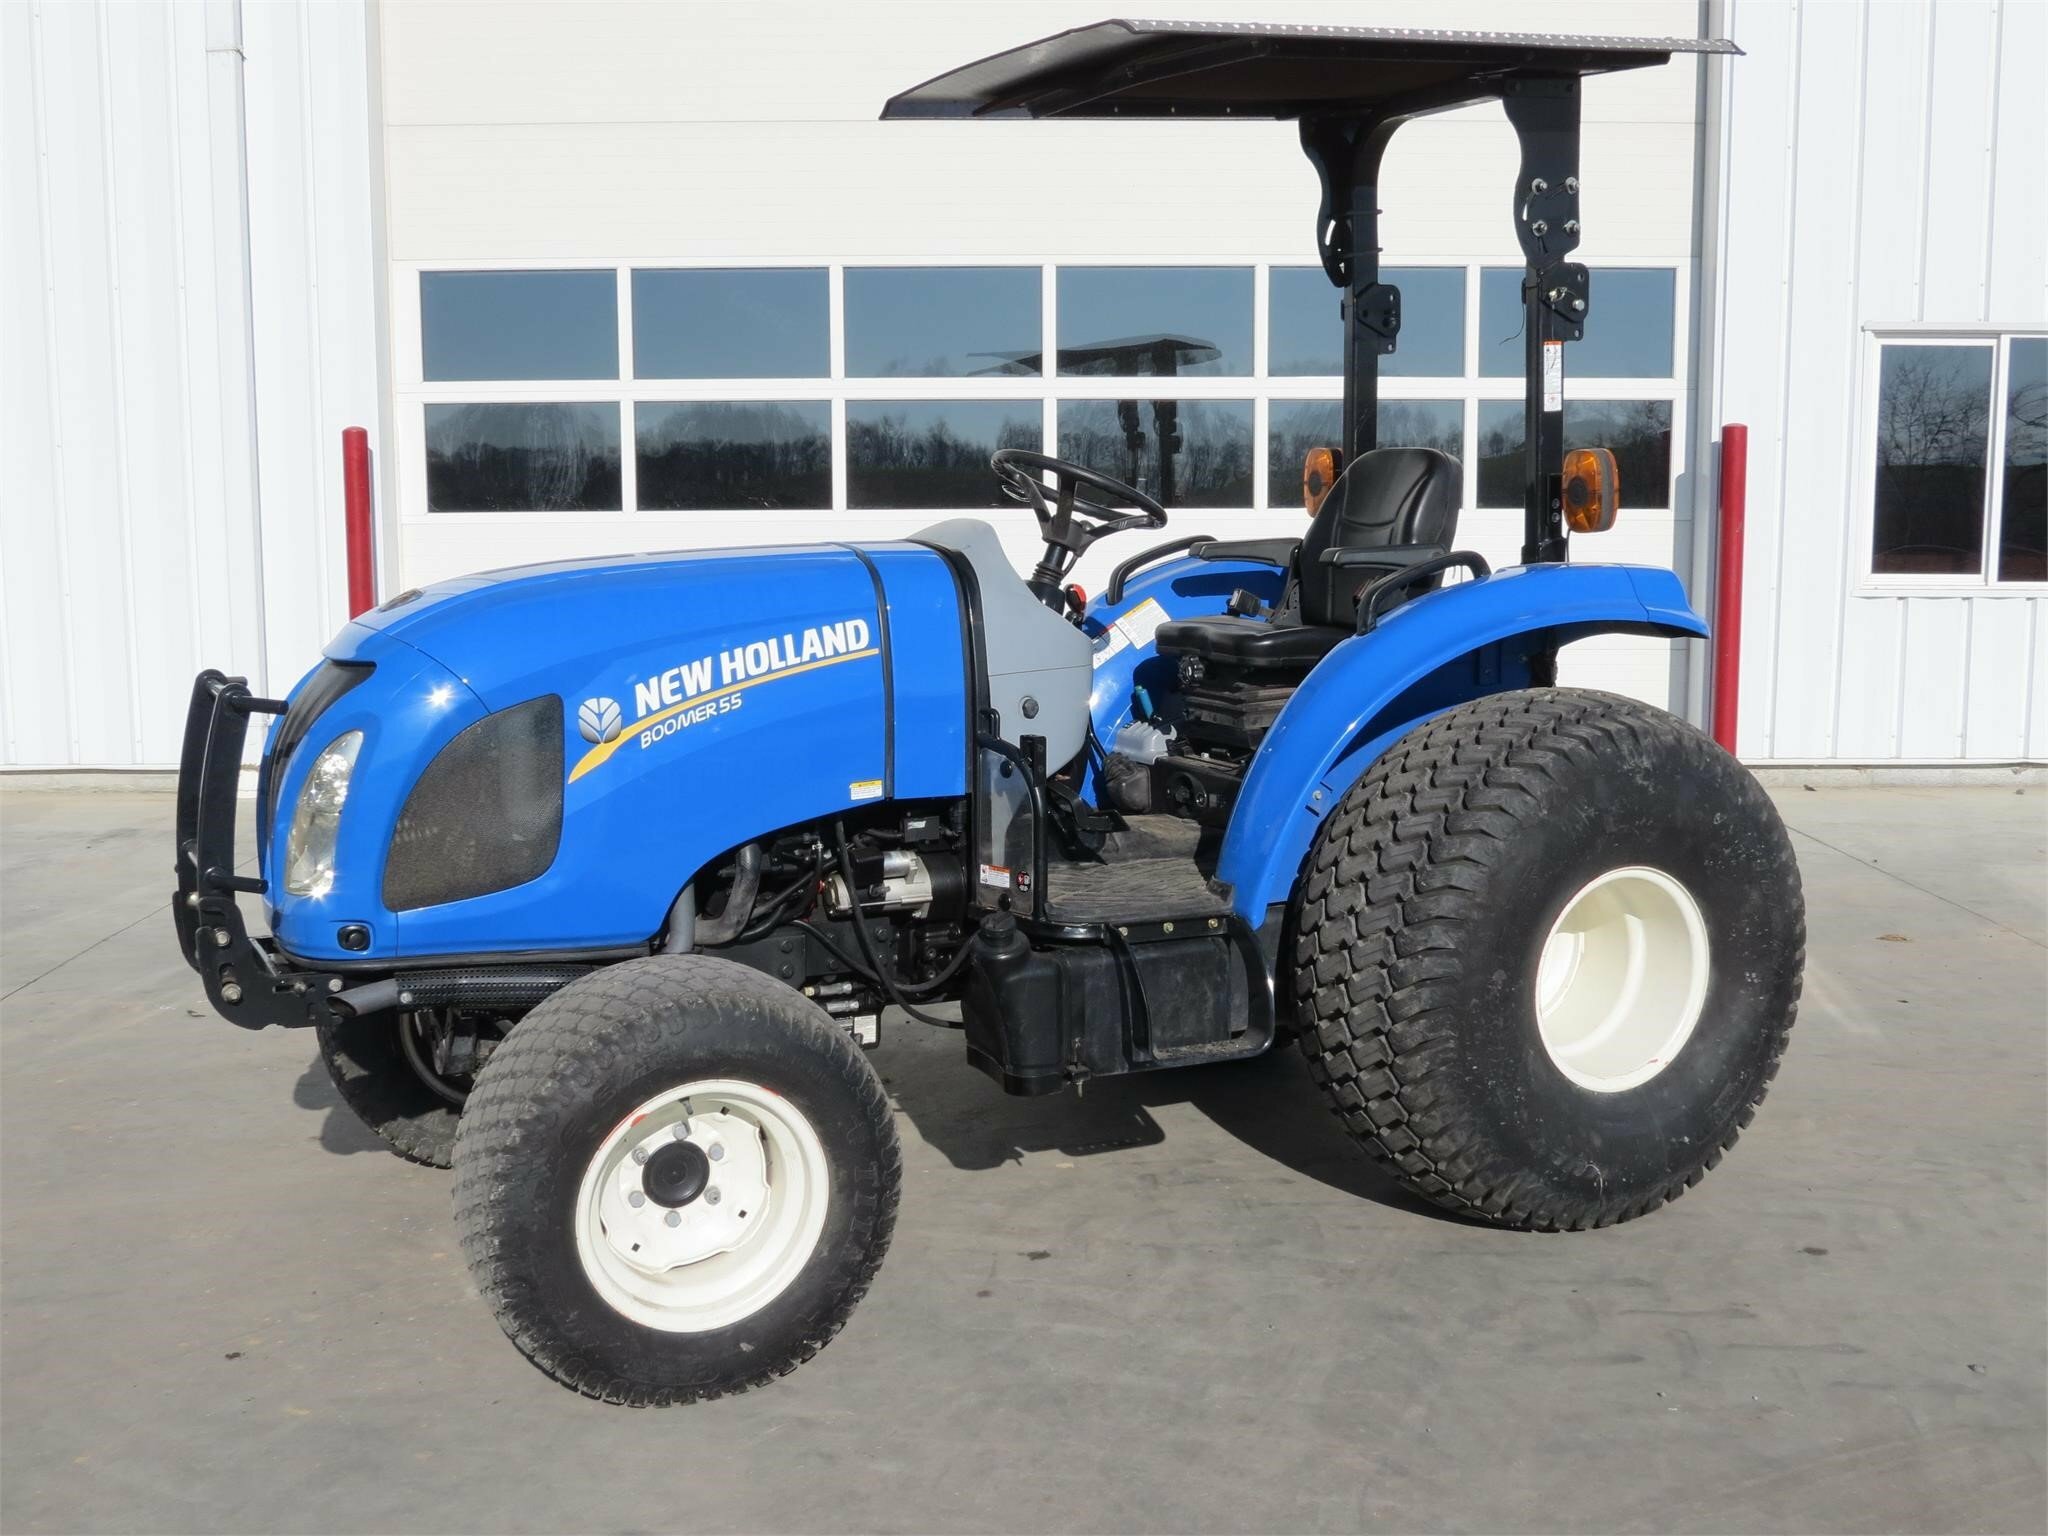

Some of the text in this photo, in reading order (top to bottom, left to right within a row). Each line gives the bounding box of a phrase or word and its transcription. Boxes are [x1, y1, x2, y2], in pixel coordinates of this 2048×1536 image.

[634, 618, 869, 719] NEW HOLLAND
[640, 692, 743, 749] BOOMER 55
